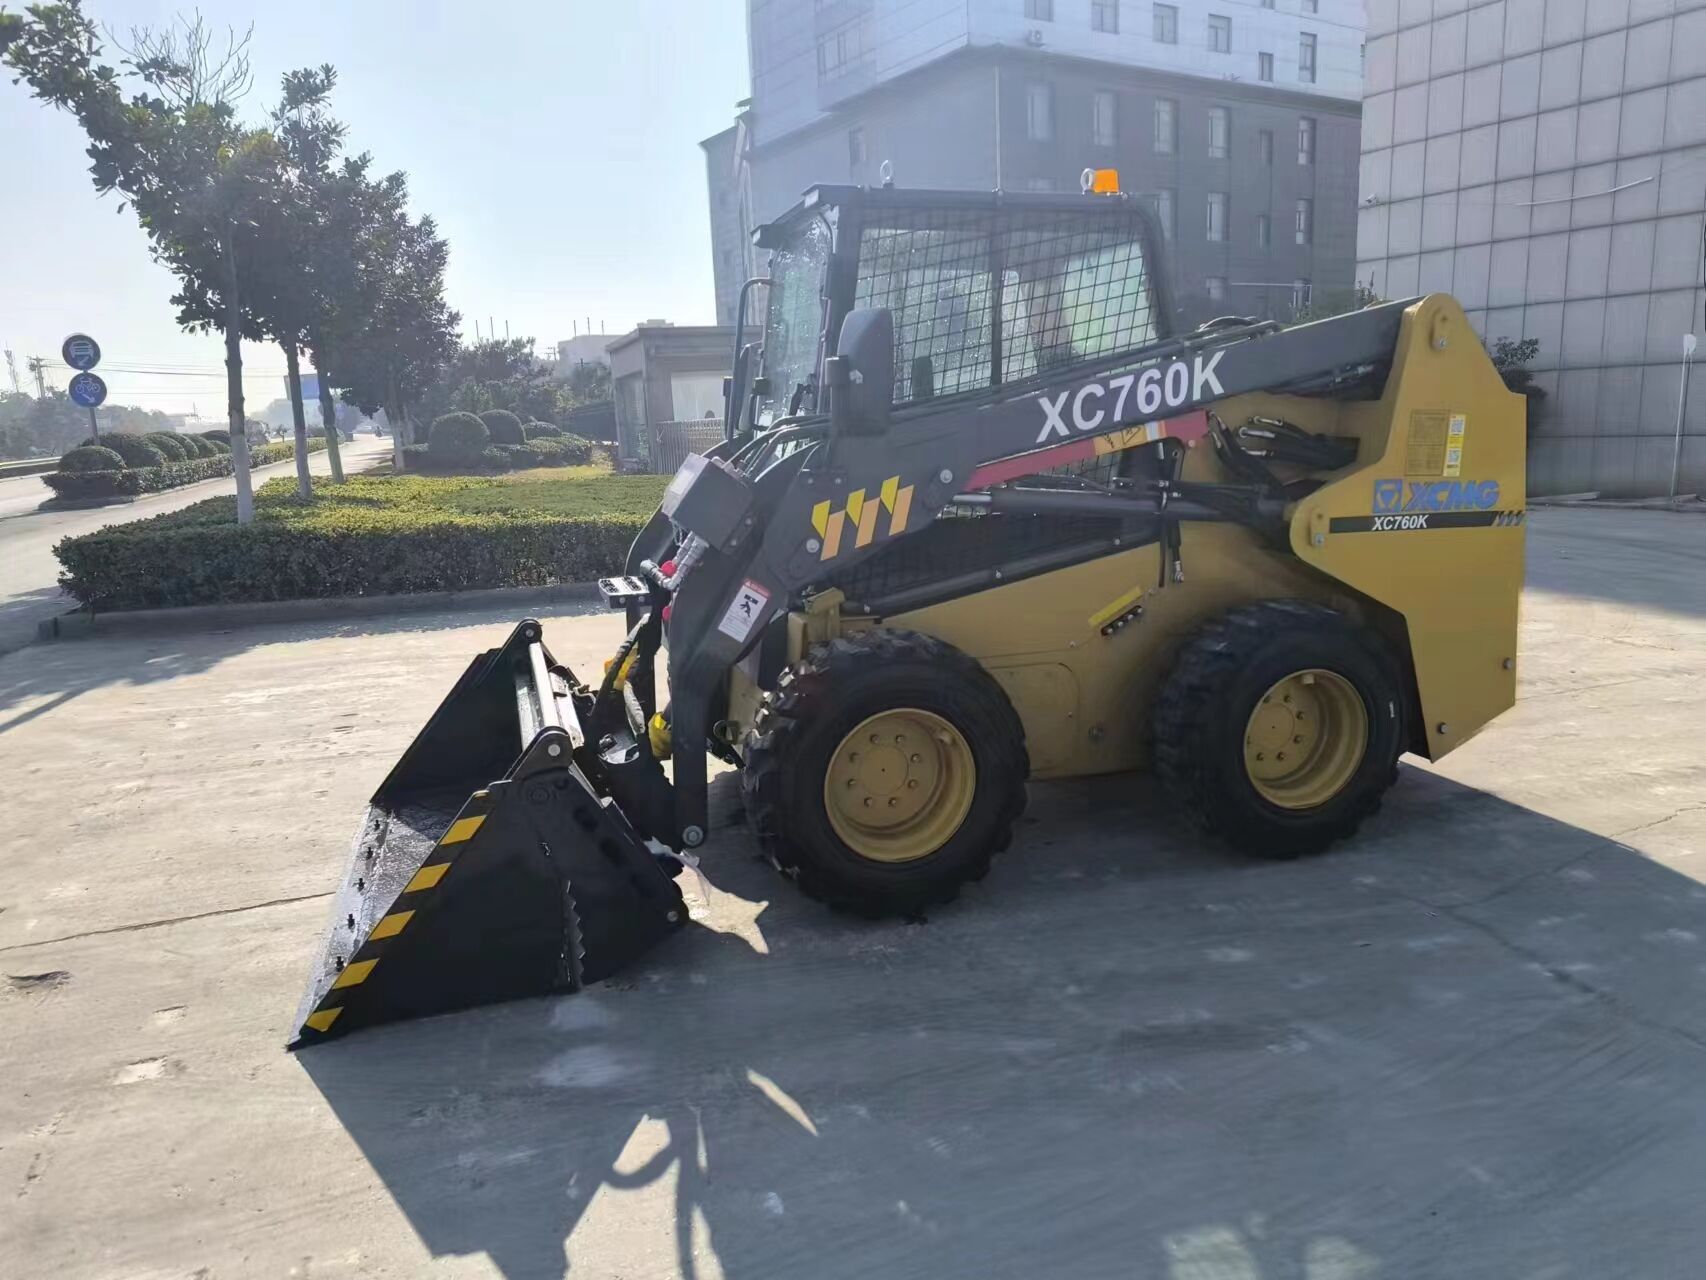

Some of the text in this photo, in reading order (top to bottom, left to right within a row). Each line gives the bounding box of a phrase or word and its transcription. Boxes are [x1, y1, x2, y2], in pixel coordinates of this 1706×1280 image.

[1035, 350, 1226, 444] XC760K
[1402, 480, 1499, 511] XCMG
[1372, 515, 1429, 531] XC760K
